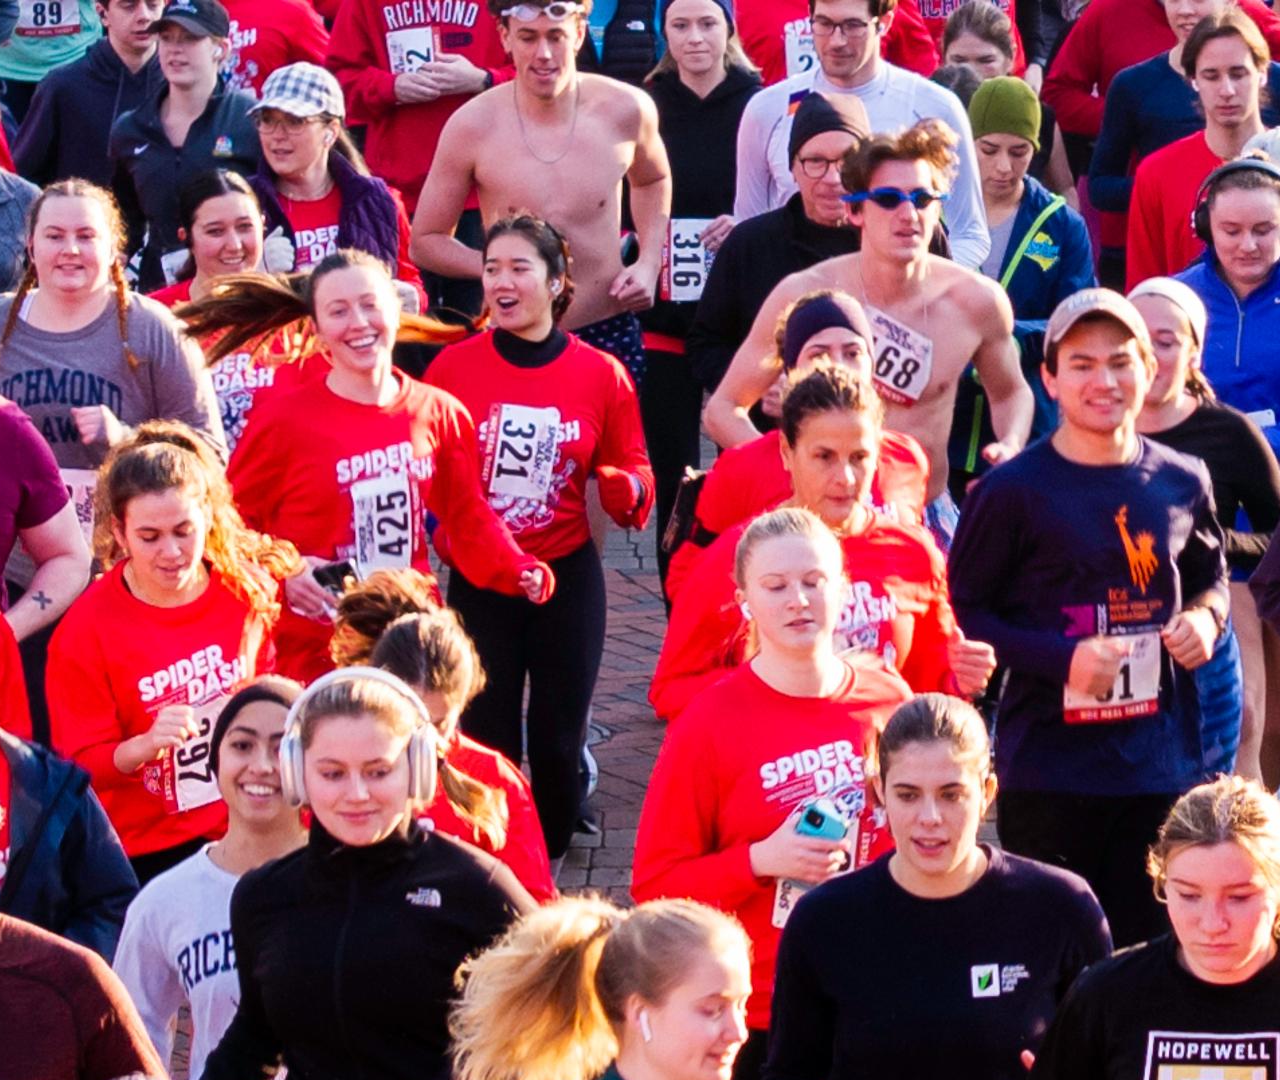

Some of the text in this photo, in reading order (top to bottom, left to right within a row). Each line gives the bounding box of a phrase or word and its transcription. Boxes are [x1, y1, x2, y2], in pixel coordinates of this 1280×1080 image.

[32, 1, 62, 27] 89
[383, 0, 479, 30] RICHMOND
[784, 17, 812, 34] SPI
[293, 225, 340, 249] IDER
[310, 239, 338, 262] DA
[672, 232, 702, 288] 316
[214, 367, 277, 391] DASH
[872, 336, 921, 390] 68
[42, 415, 81, 444] AW
[495, 418, 537, 480] 321
[336, 442, 414, 484] SPIDER
[376, 489, 410, 557] 425
[139, 644, 224, 696] SPIDER
[187, 654, 248, 704] DASH
[759, 739, 854, 790] SPIDER
[814, 755, 865, 794] DAS
[779, 881, 792, 910] SPID
[177, 929, 238, 990] RICH
[1157, 1040, 1271, 1061] HOPEWELL
